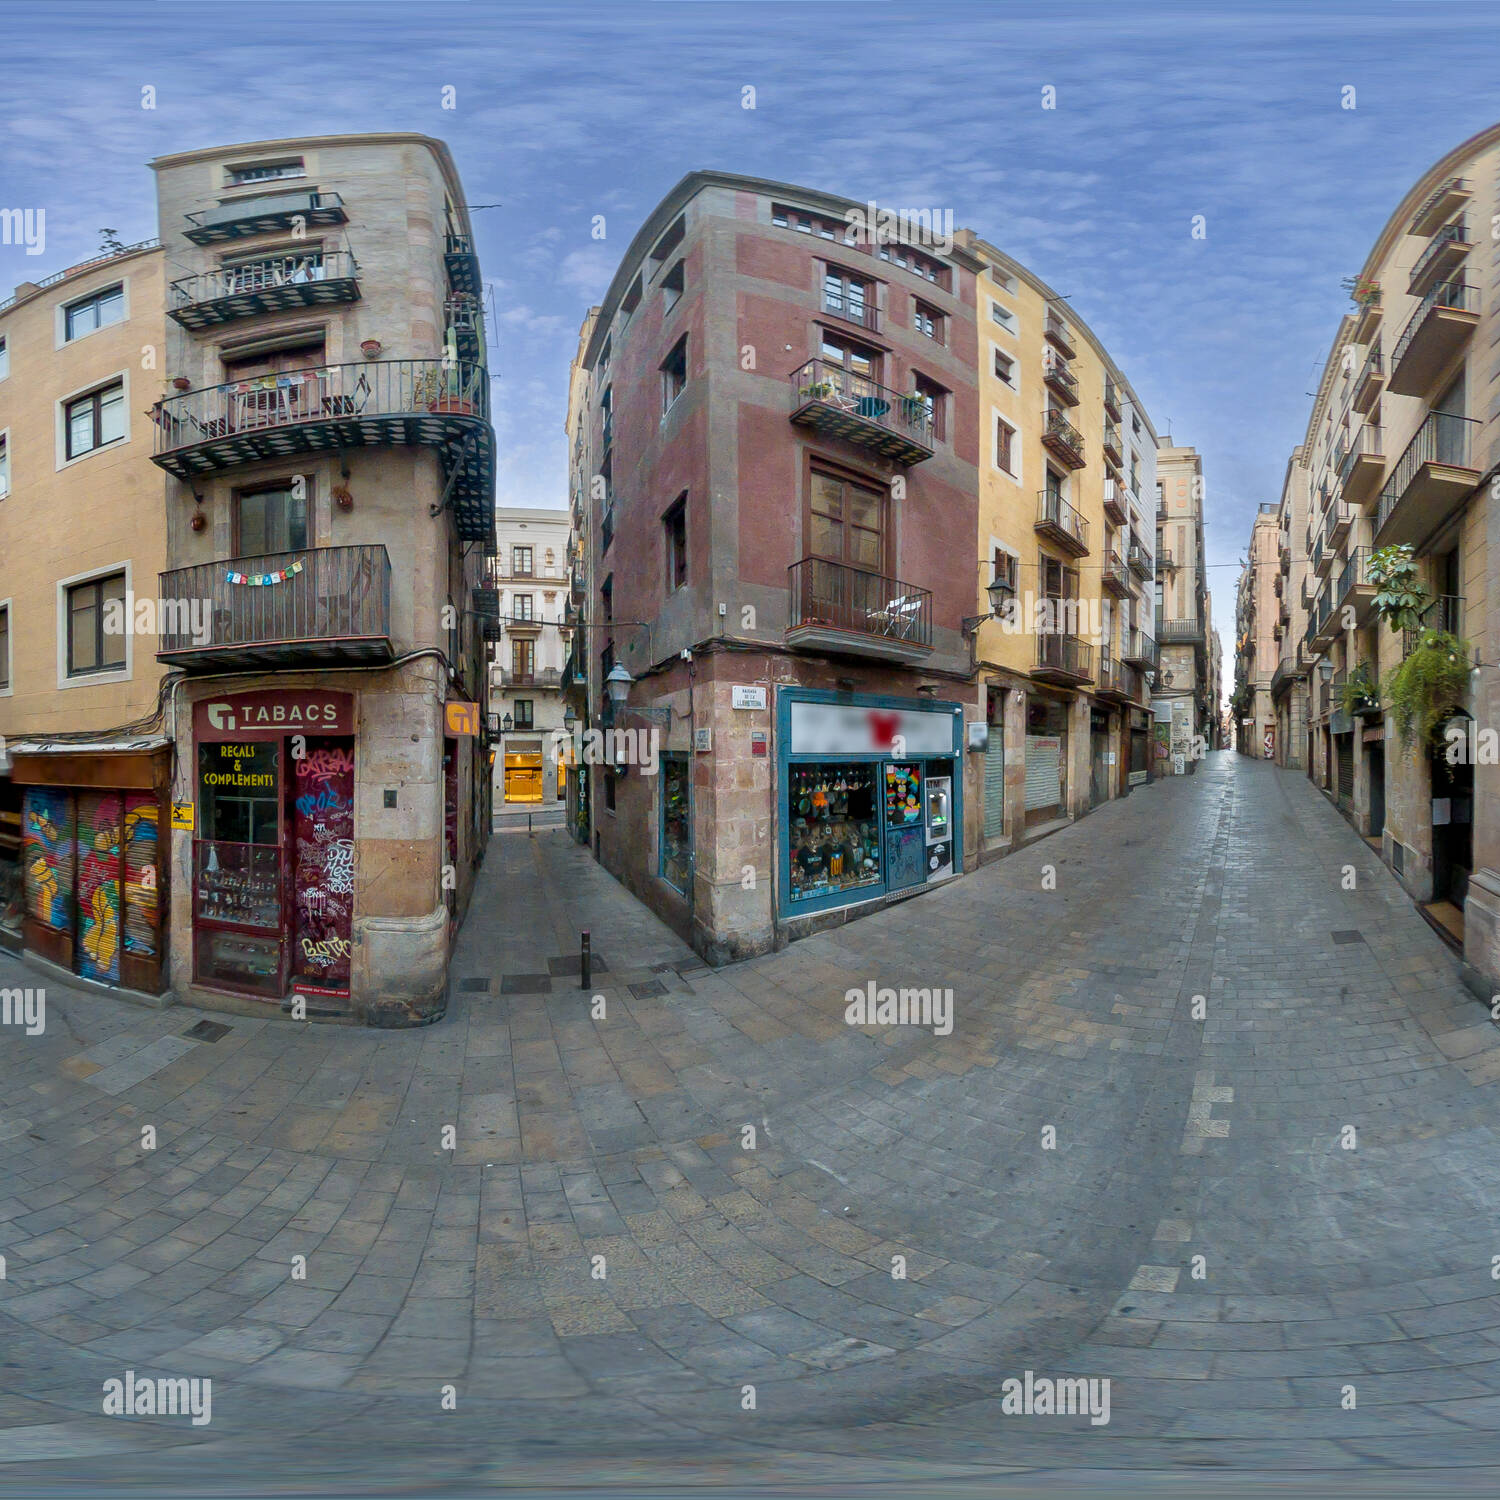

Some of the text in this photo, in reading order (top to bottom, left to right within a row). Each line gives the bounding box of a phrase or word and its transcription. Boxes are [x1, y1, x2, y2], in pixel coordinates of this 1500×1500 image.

[241, 704, 337, 722] TABACS
[220, 745, 255, 758] REGALS
[233, 759, 241, 772] &
[203, 773, 274, 787] COMPLEMENTS
